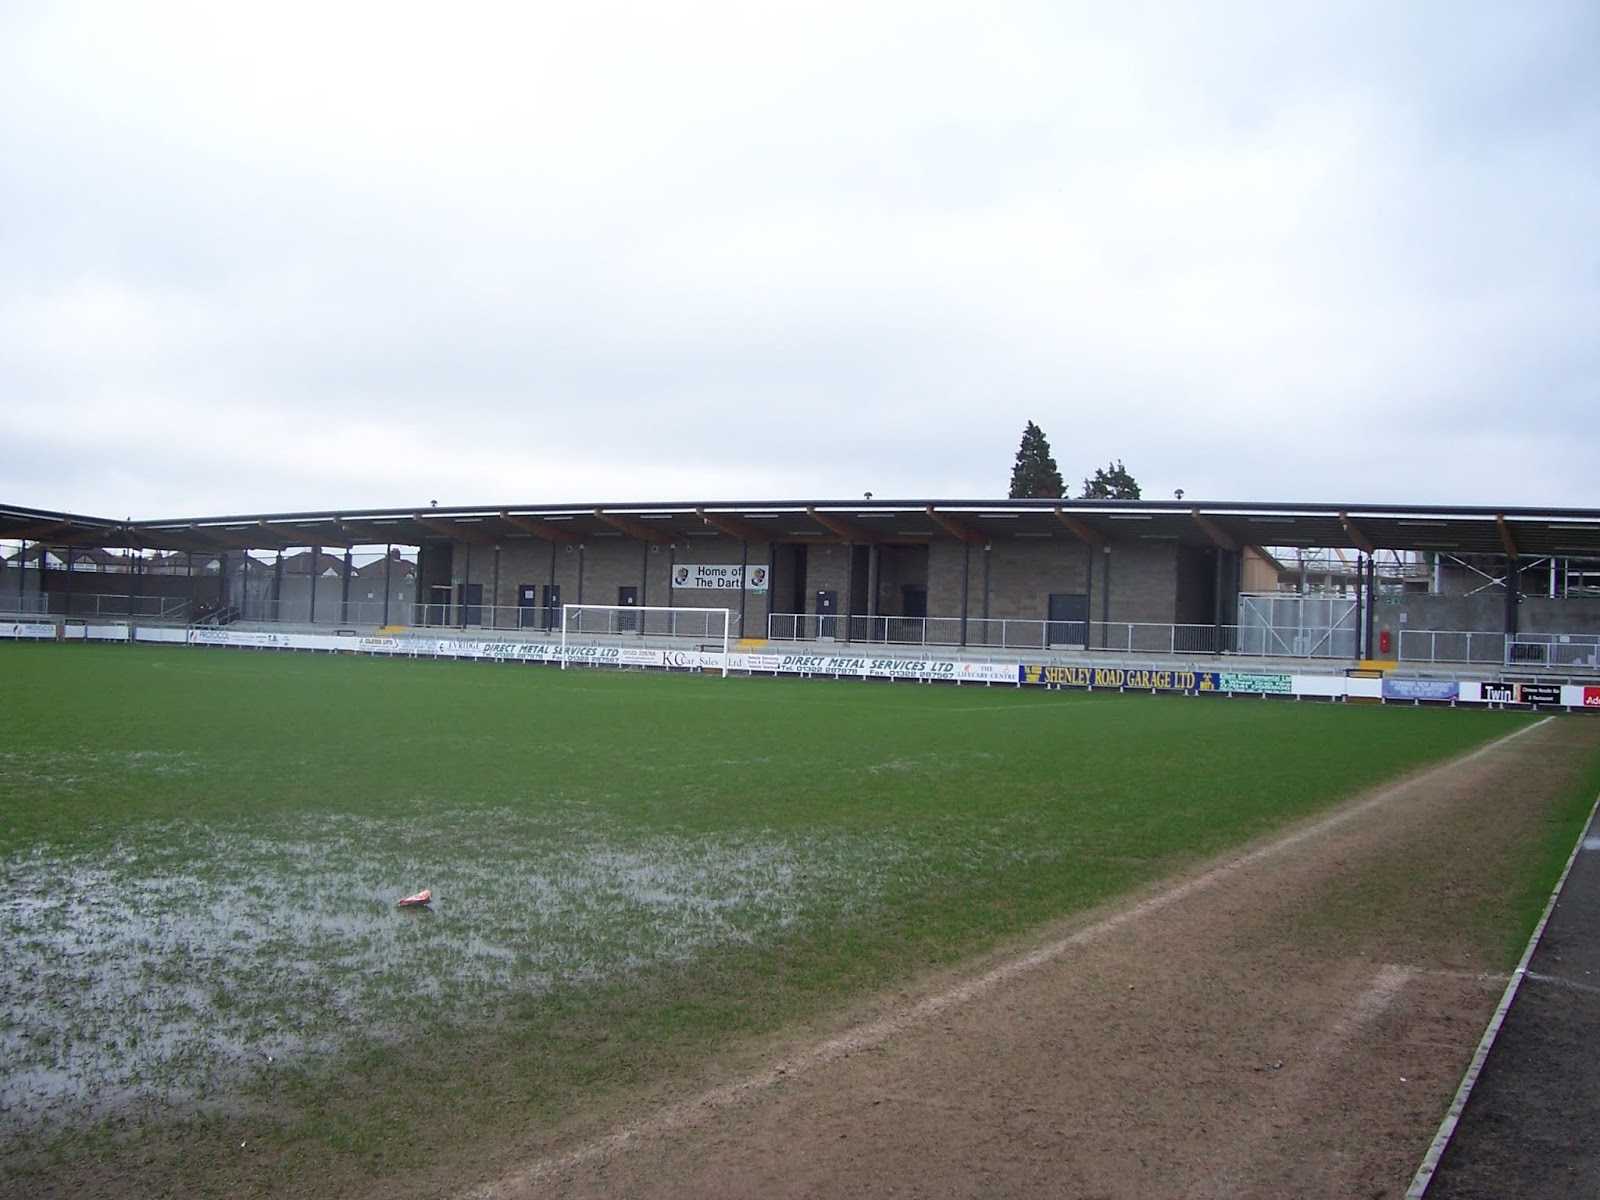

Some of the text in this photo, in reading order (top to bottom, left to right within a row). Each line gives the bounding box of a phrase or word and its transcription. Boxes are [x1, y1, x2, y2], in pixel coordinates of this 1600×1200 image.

[698, 566, 742, 577] Home of
[695, 577, 713, 587] The
[200, 630, 229, 640] PROTOCOL
[483, 643, 516, 653] DIRECT
[519, 645, 549, 655] METAL
[552, 646, 597, 657] SERVICES
[600, 649, 619, 658] LTD
[699, 656, 719, 666] Sales
[728, 657, 742, 667] Ltd
[782, 656, 954, 672] DIRECT METAL SERVICES LTD
[796, 665, 822, 673] 01322
[919, 671, 955, 679] 287567
[957, 671, 1015, 680] LIFECARE CENTRE
[1045, 667, 1092, 685] SHENLEY
[1094, 669, 1125, 687] ROAD
[1127, 670, 1171, 689] GARAGE
[1174, 672, 1196, 689] LTD
[1484, 686, 1512, 703] Twin
